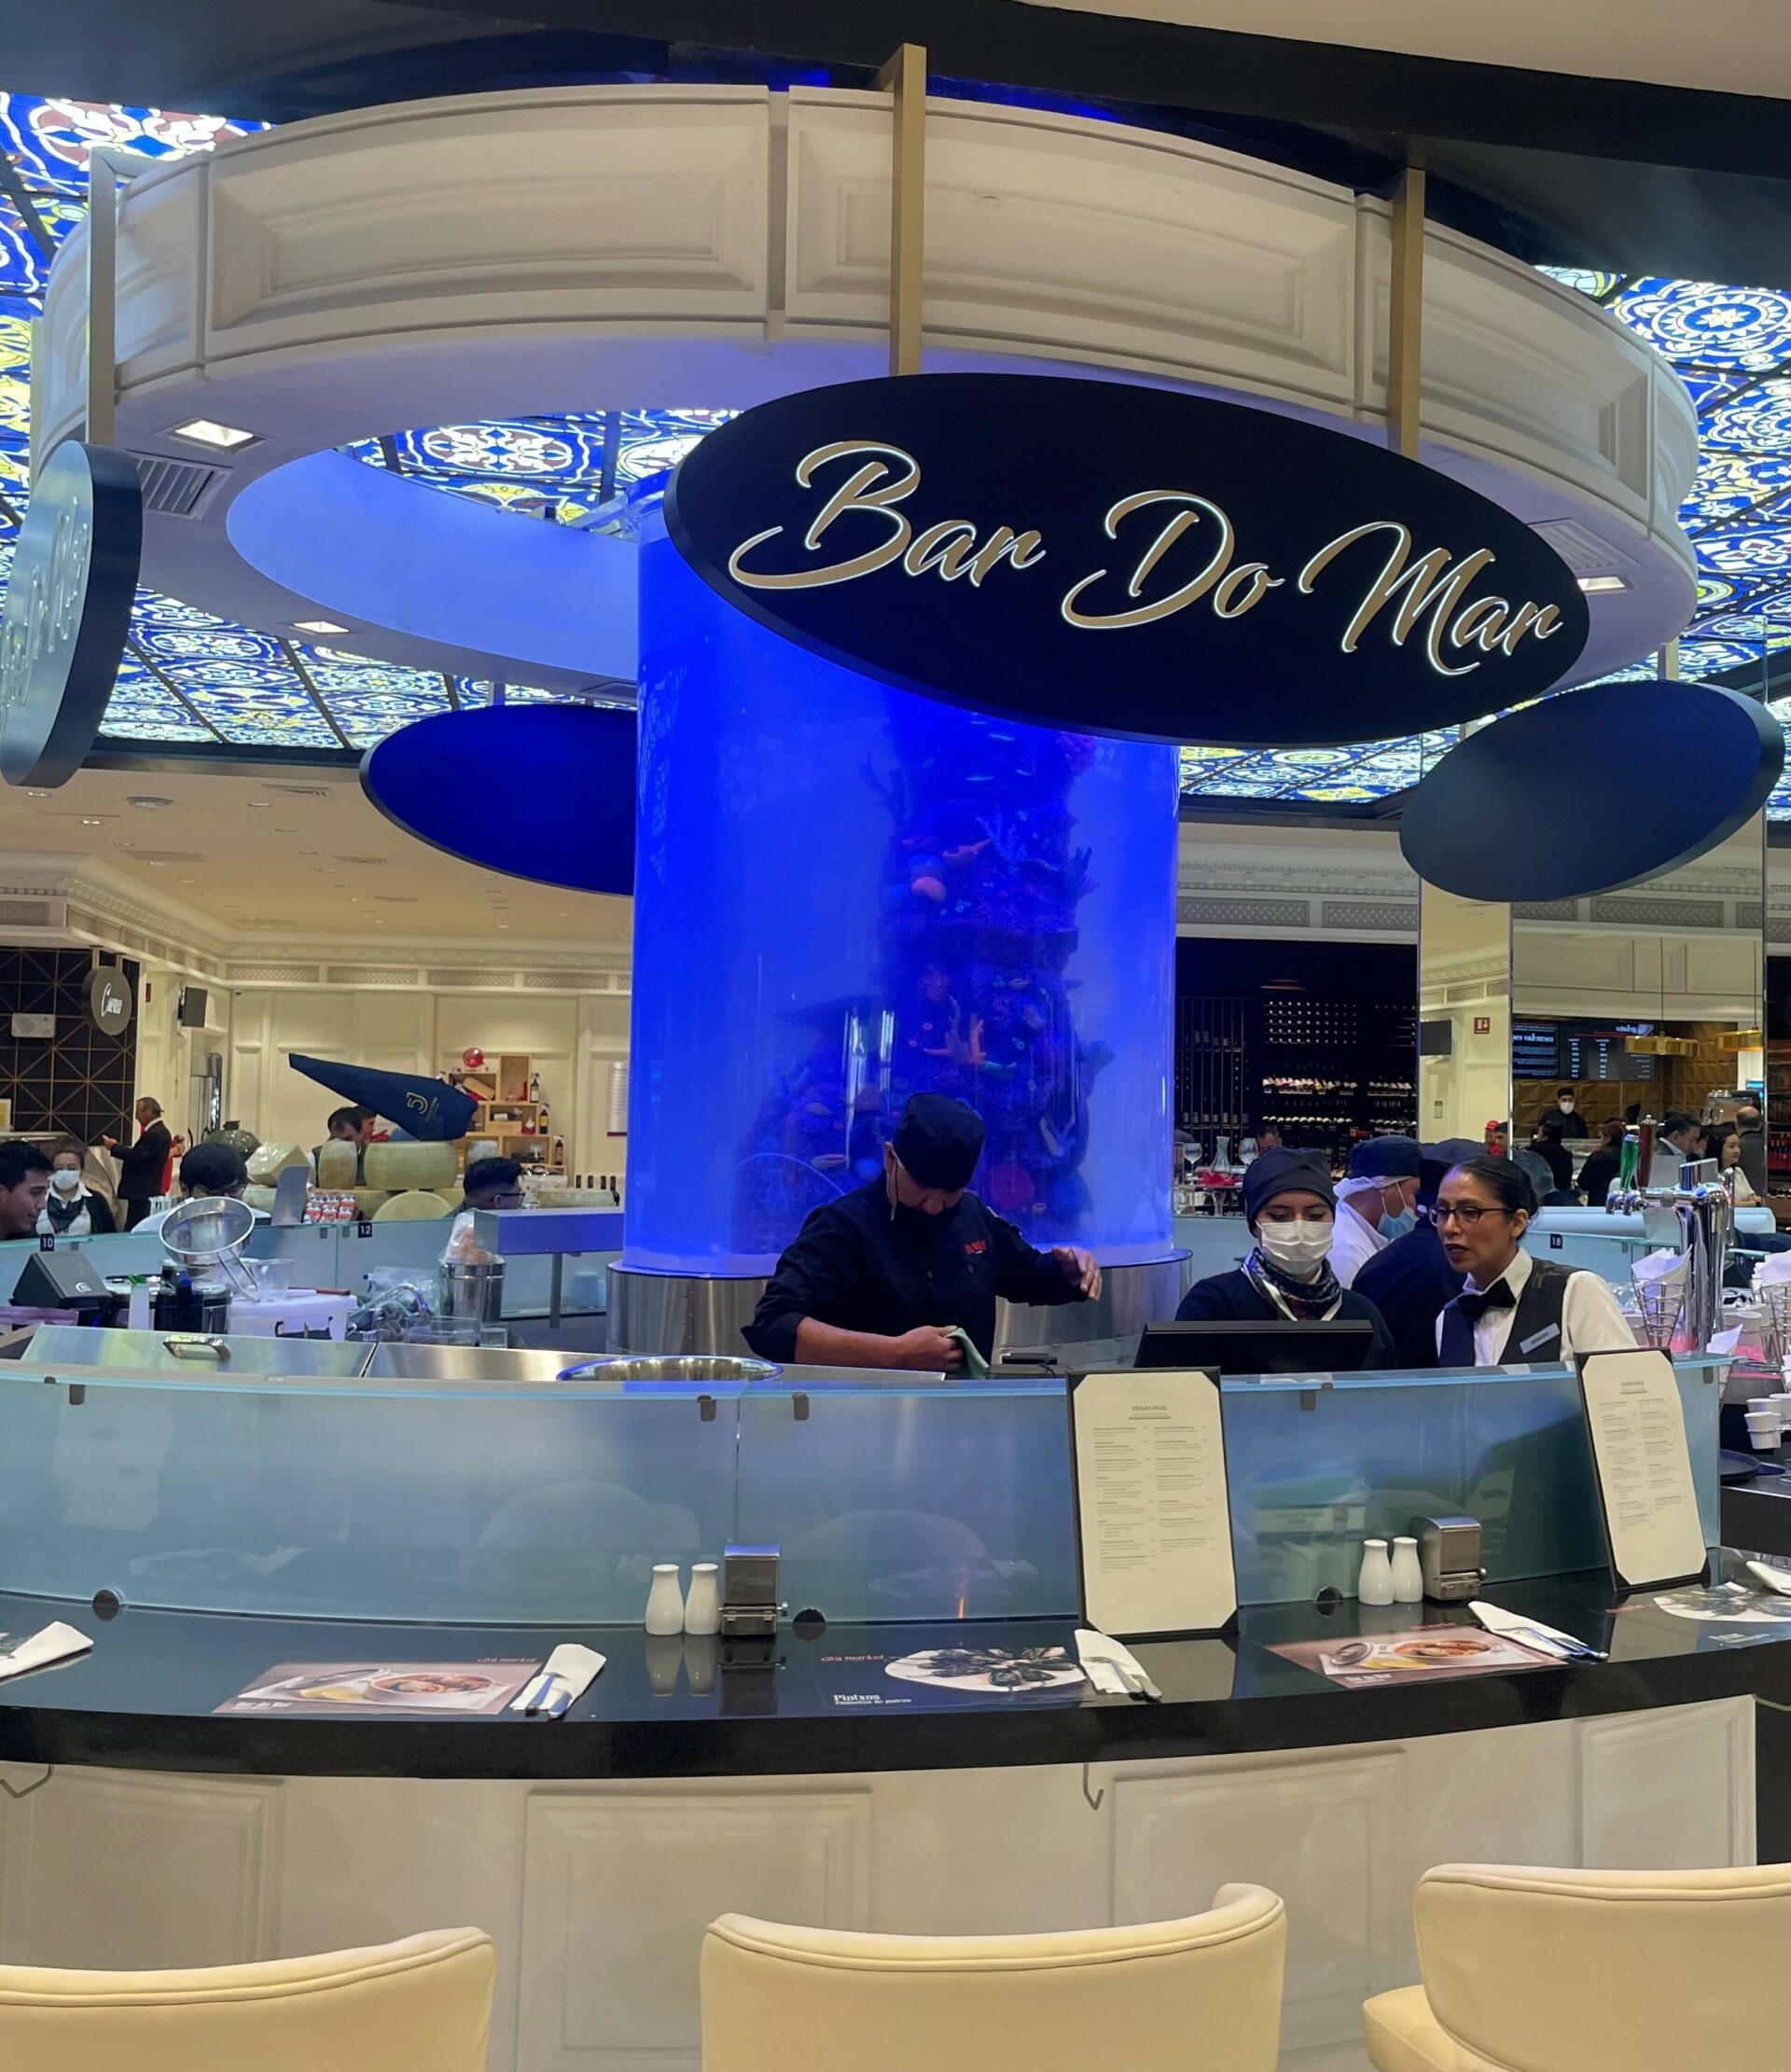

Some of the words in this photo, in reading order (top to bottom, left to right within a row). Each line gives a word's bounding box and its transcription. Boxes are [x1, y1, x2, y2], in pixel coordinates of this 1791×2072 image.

[728, 440, 1048, 590] Bar
[1061, 489, 1286, 630] Do
[1298, 520, 1564, 677] Mar
[360, 1224, 371, 1235] 12
[42, 1237, 53, 1248] 10
[1551, 1236, 1562, 1246] 18
[833, 1693, 882, 1702] Pintxos
